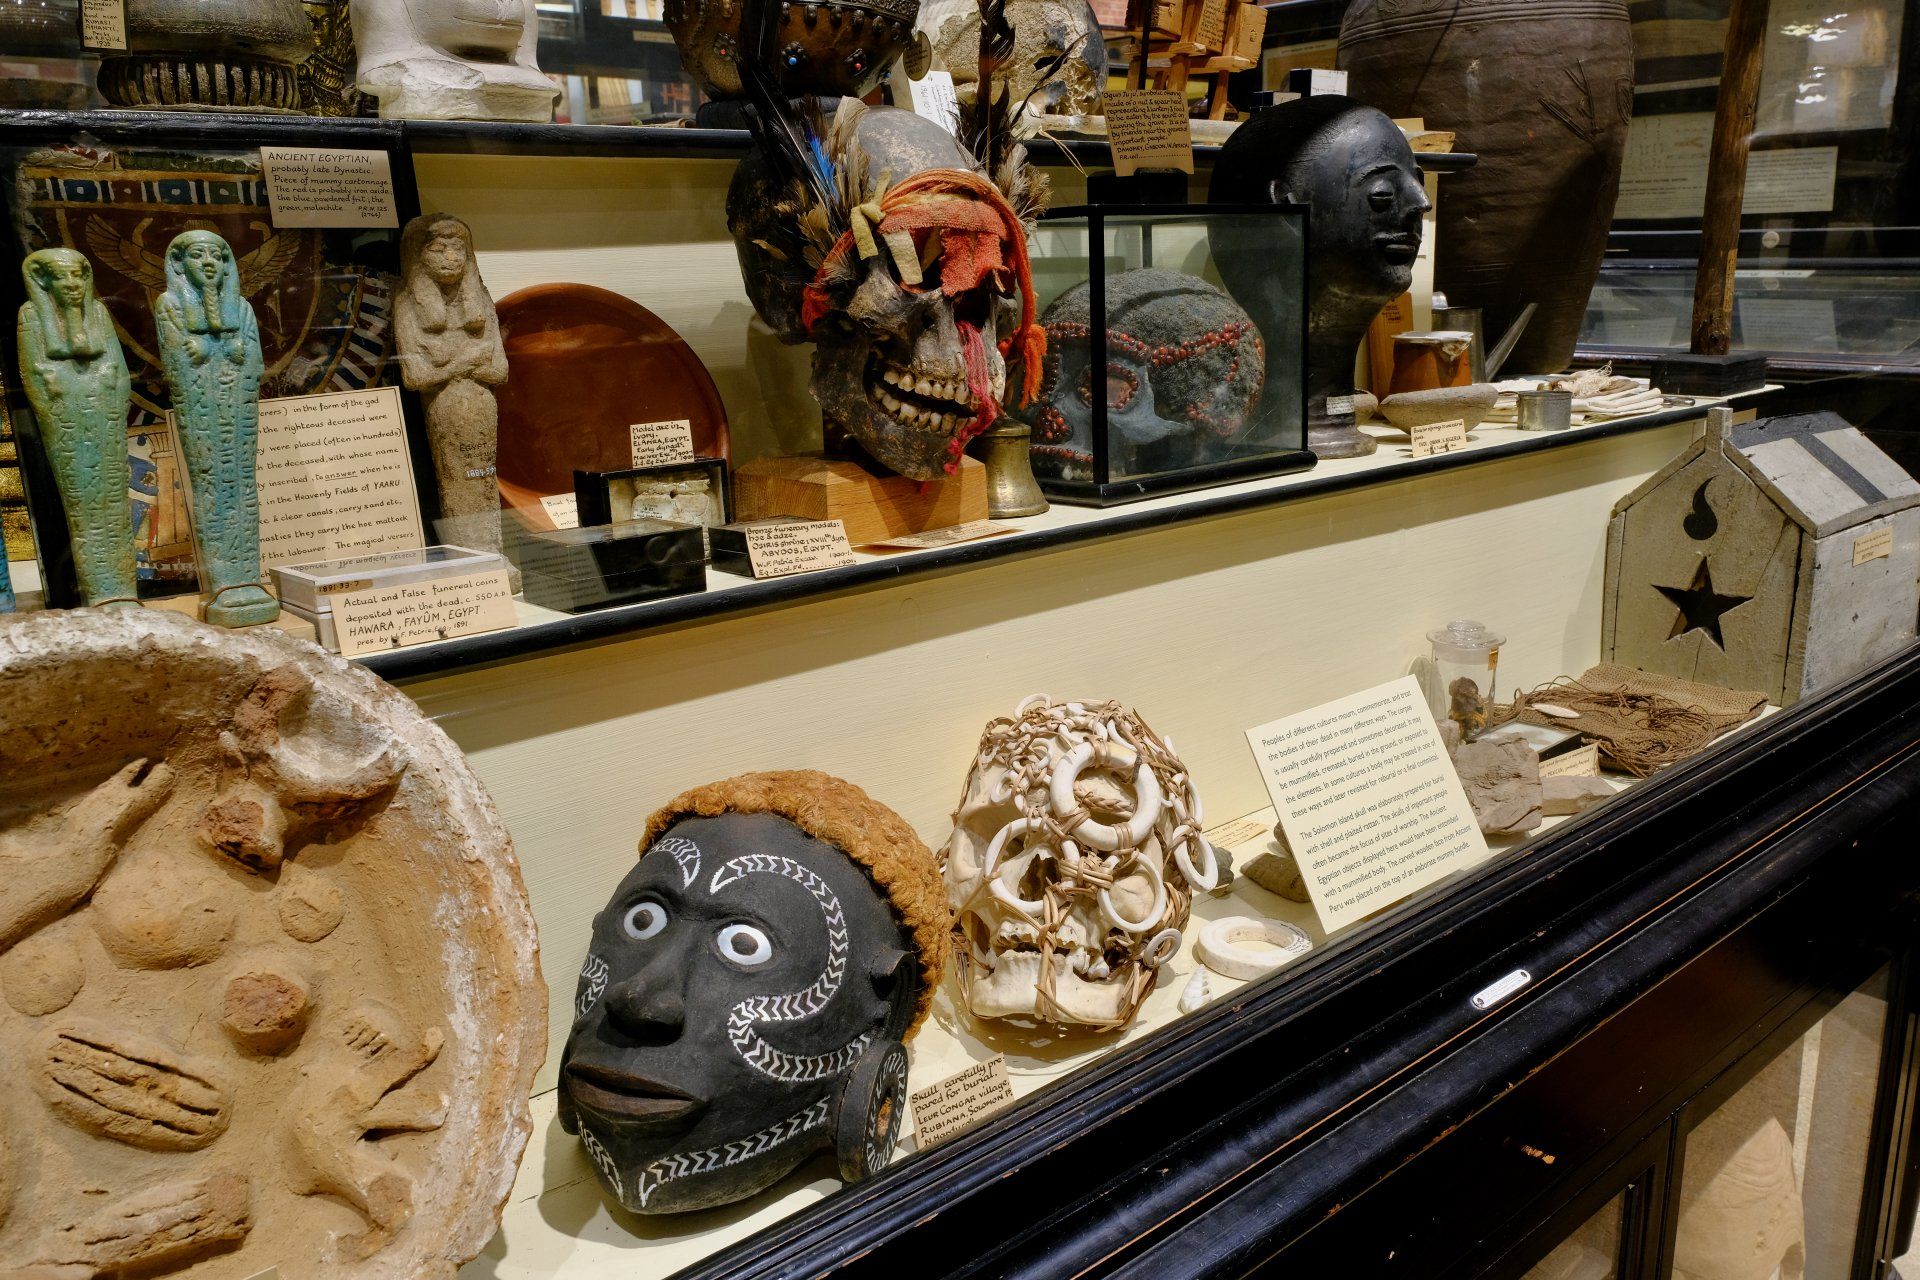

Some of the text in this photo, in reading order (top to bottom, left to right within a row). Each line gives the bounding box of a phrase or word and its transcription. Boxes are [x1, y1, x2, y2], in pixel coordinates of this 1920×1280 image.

[267, 152, 372, 165] ANCIENT EGYPTIAN,
[271, 164, 374, 176] probably late Dynastic.
[273, 174, 298, 184] Piece
[300, 175, 309, 186] of
[310, 178, 343, 187] mummy
[274, 185, 291, 194] The
[292, 185, 307, 193] red
[318, 186, 352, 195] probably
[276, 194, 291, 202] the
[313, 194, 351, 204] powdered
[371, 195, 385, 204] the
[302, 404, 318, 413] the
[319, 402, 339, 412] form
[340, 399, 349, 410] of
[350, 399, 364, 407] the
[364, 396, 380, 408] god
[263, 414, 388, 435] the righteous deceased were
[632, 423, 655, 434] Model
[269, 444, 290, 452] were
[293, 438, 322, 450] placed
[323, 436, 351, 447] (often
[361, 427, 402, 440] hundreds)
[267, 461, 283, 470] the
[328, 453, 345, 462] with
[348, 451, 373, 460] whose
[375, 448, 399, 456] name
[315, 473, 324, 481] to
[324, 470, 359, 482] answer
[359, 466, 381, 474] when
[277, 496, 293, 504] the
[294, 489, 332, 501] Heavenly
[334, 486, 359, 496] Fields
[361, 483, 370, 493] of
[373, 479, 400, 490] YAARU
[280, 513, 303, 522] clear
[338, 505, 362, 514] carry
[363, 500, 385, 510] sand
[259, 514, 409, 543] nasties they carry the hoe mattock
[746, 527, 773, 536] Bronze
[773, 525, 810, 533] funerary
[773, 532, 797, 540] adze.
[268, 551, 285, 559] the
[334, 541, 352, 550] The
[353, 534, 385, 549] magical
[751, 541, 780, 551] OSIRIS
[761, 544, 834, 558] ABYDOS, EGYPT.
[343, 577, 499, 608] Actual and False funereal coins
[345, 607, 392, 624] deposited
[395, 604, 416, 615] with
[418, 602, 434, 611] the
[378, 635, 389, 645] by
[1261, 734, 1286, 748] Peoples
[1292, 723, 1317, 737] different
[1316, 716, 1338, 729] cultures
[1299, 831, 1313, 841] The
[1311, 820, 1339, 836] Solomon
[1337, 811, 1355, 826] Island
[1354, 806, 1367, 819] skull
[1366, 804, 1378, 813] was
[1328, 902, 1344, 914] Peru
[1343, 897, 1356, 907] was
[1355, 886, 1374, 904] placed
[1373, 884, 1383, 893] on
[1381, 880, 1392, 889] the
[1391, 875, 1402, 884] top
[1414, 858, 1437, 873] elaborate
[911, 1084, 939, 1104] Skull
[944, 1064, 987, 1089] carefully
[914, 1068, 998, 1116] pared for burial.
[978, 1079, 1010, 1098] village,
